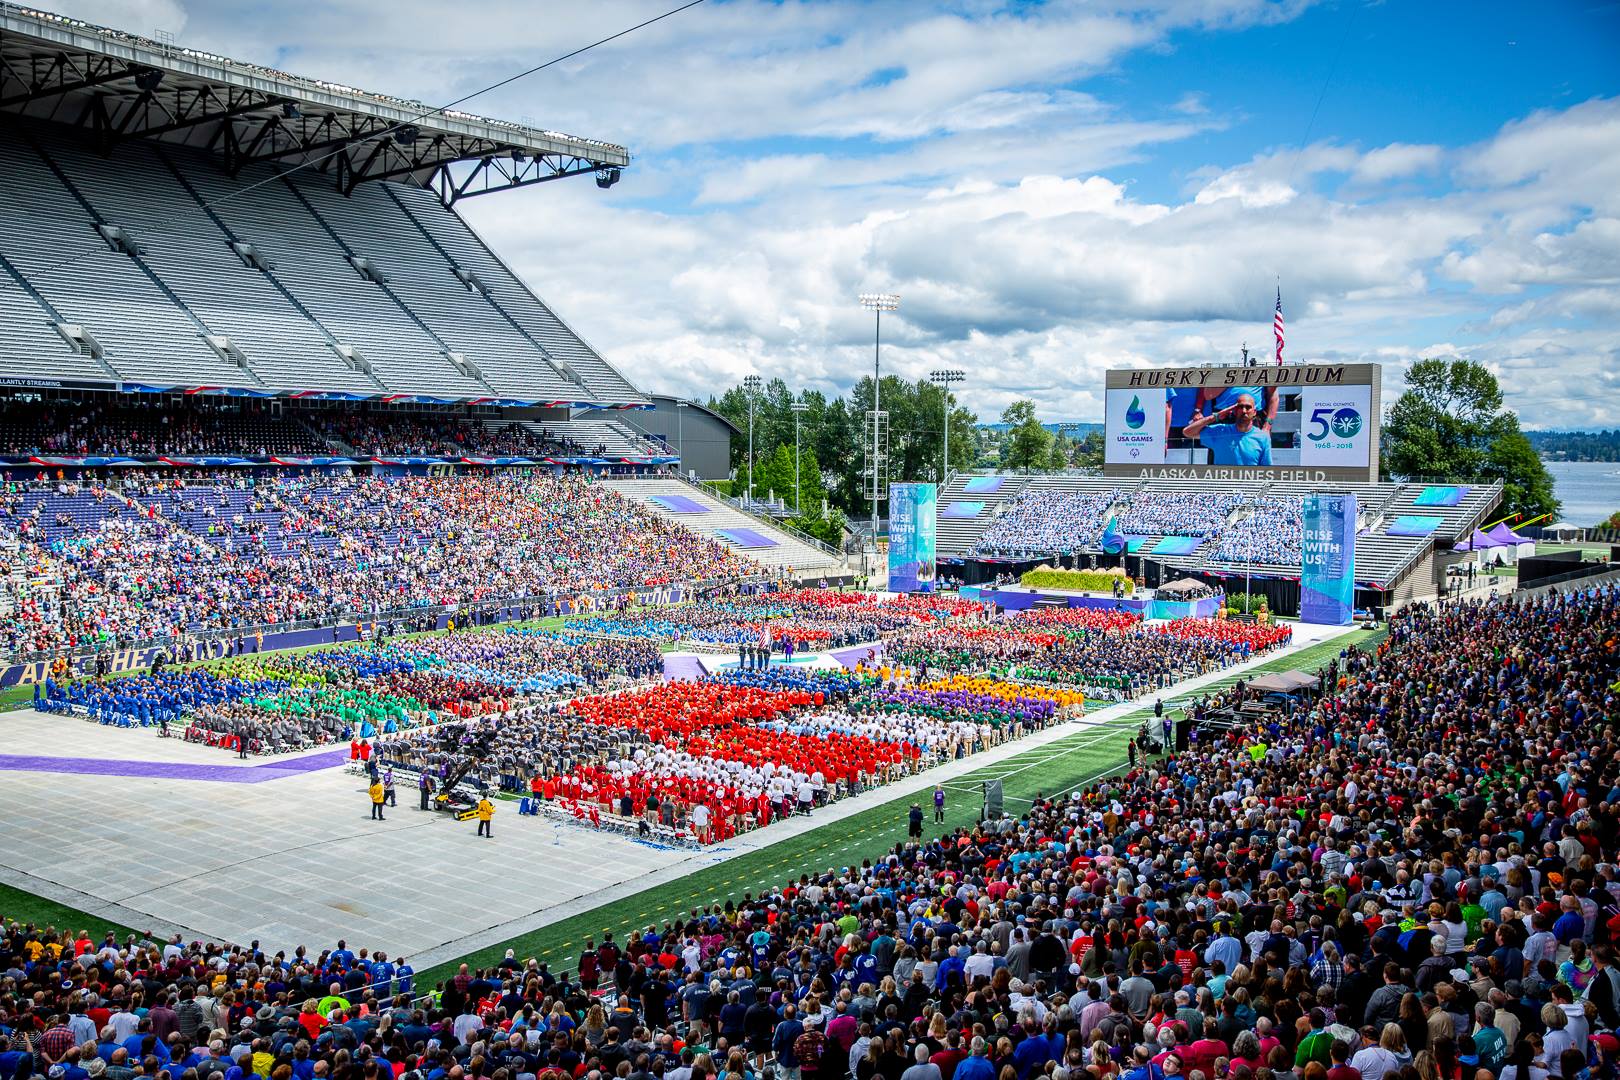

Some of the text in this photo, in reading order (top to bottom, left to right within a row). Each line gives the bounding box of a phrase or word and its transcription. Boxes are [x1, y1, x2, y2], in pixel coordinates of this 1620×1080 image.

[1129, 367, 1345, 386] HUSKY STADIUM
[1140, 468, 1326, 482] ALASKA AIRLINES FIELD
[891, 513, 911, 522] RISE
[890, 524, 915, 533] WITH
[1306, 530, 1333, 541] RISE
[1305, 542, 1340, 553] WITH
[1305, 554, 1326, 565] US.
